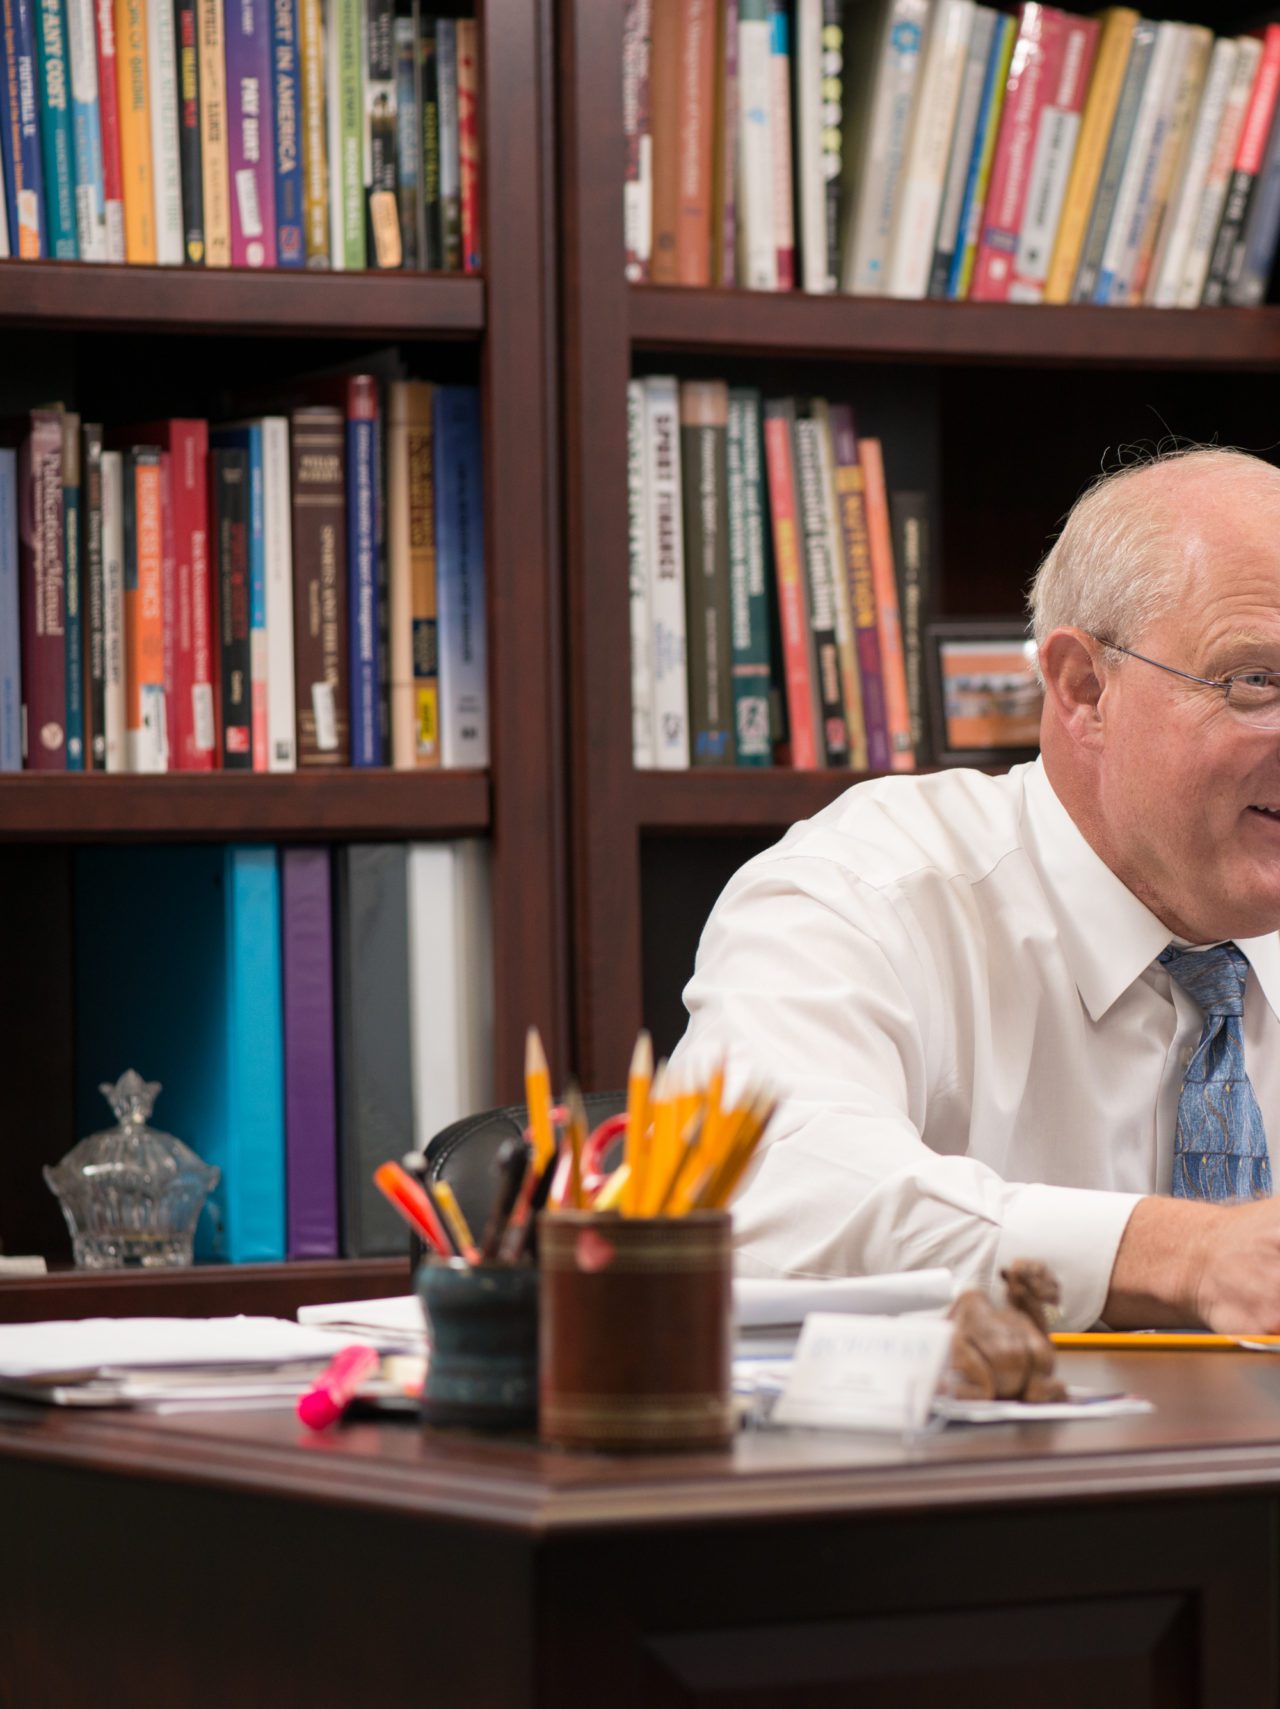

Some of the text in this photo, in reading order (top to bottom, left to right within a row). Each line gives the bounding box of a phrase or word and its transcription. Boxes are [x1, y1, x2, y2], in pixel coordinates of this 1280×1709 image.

[42, 13, 62, 57] ANY
[46, 59, 66, 111] COST
[277, 46, 294, 71] IN
[276, 74, 298, 174] AMERICA
[43, 453, 64, 635] Publication Manual
[141, 473, 160, 619] BUSINESS ETHICS
[843, 495, 875, 628] NUTRITION
